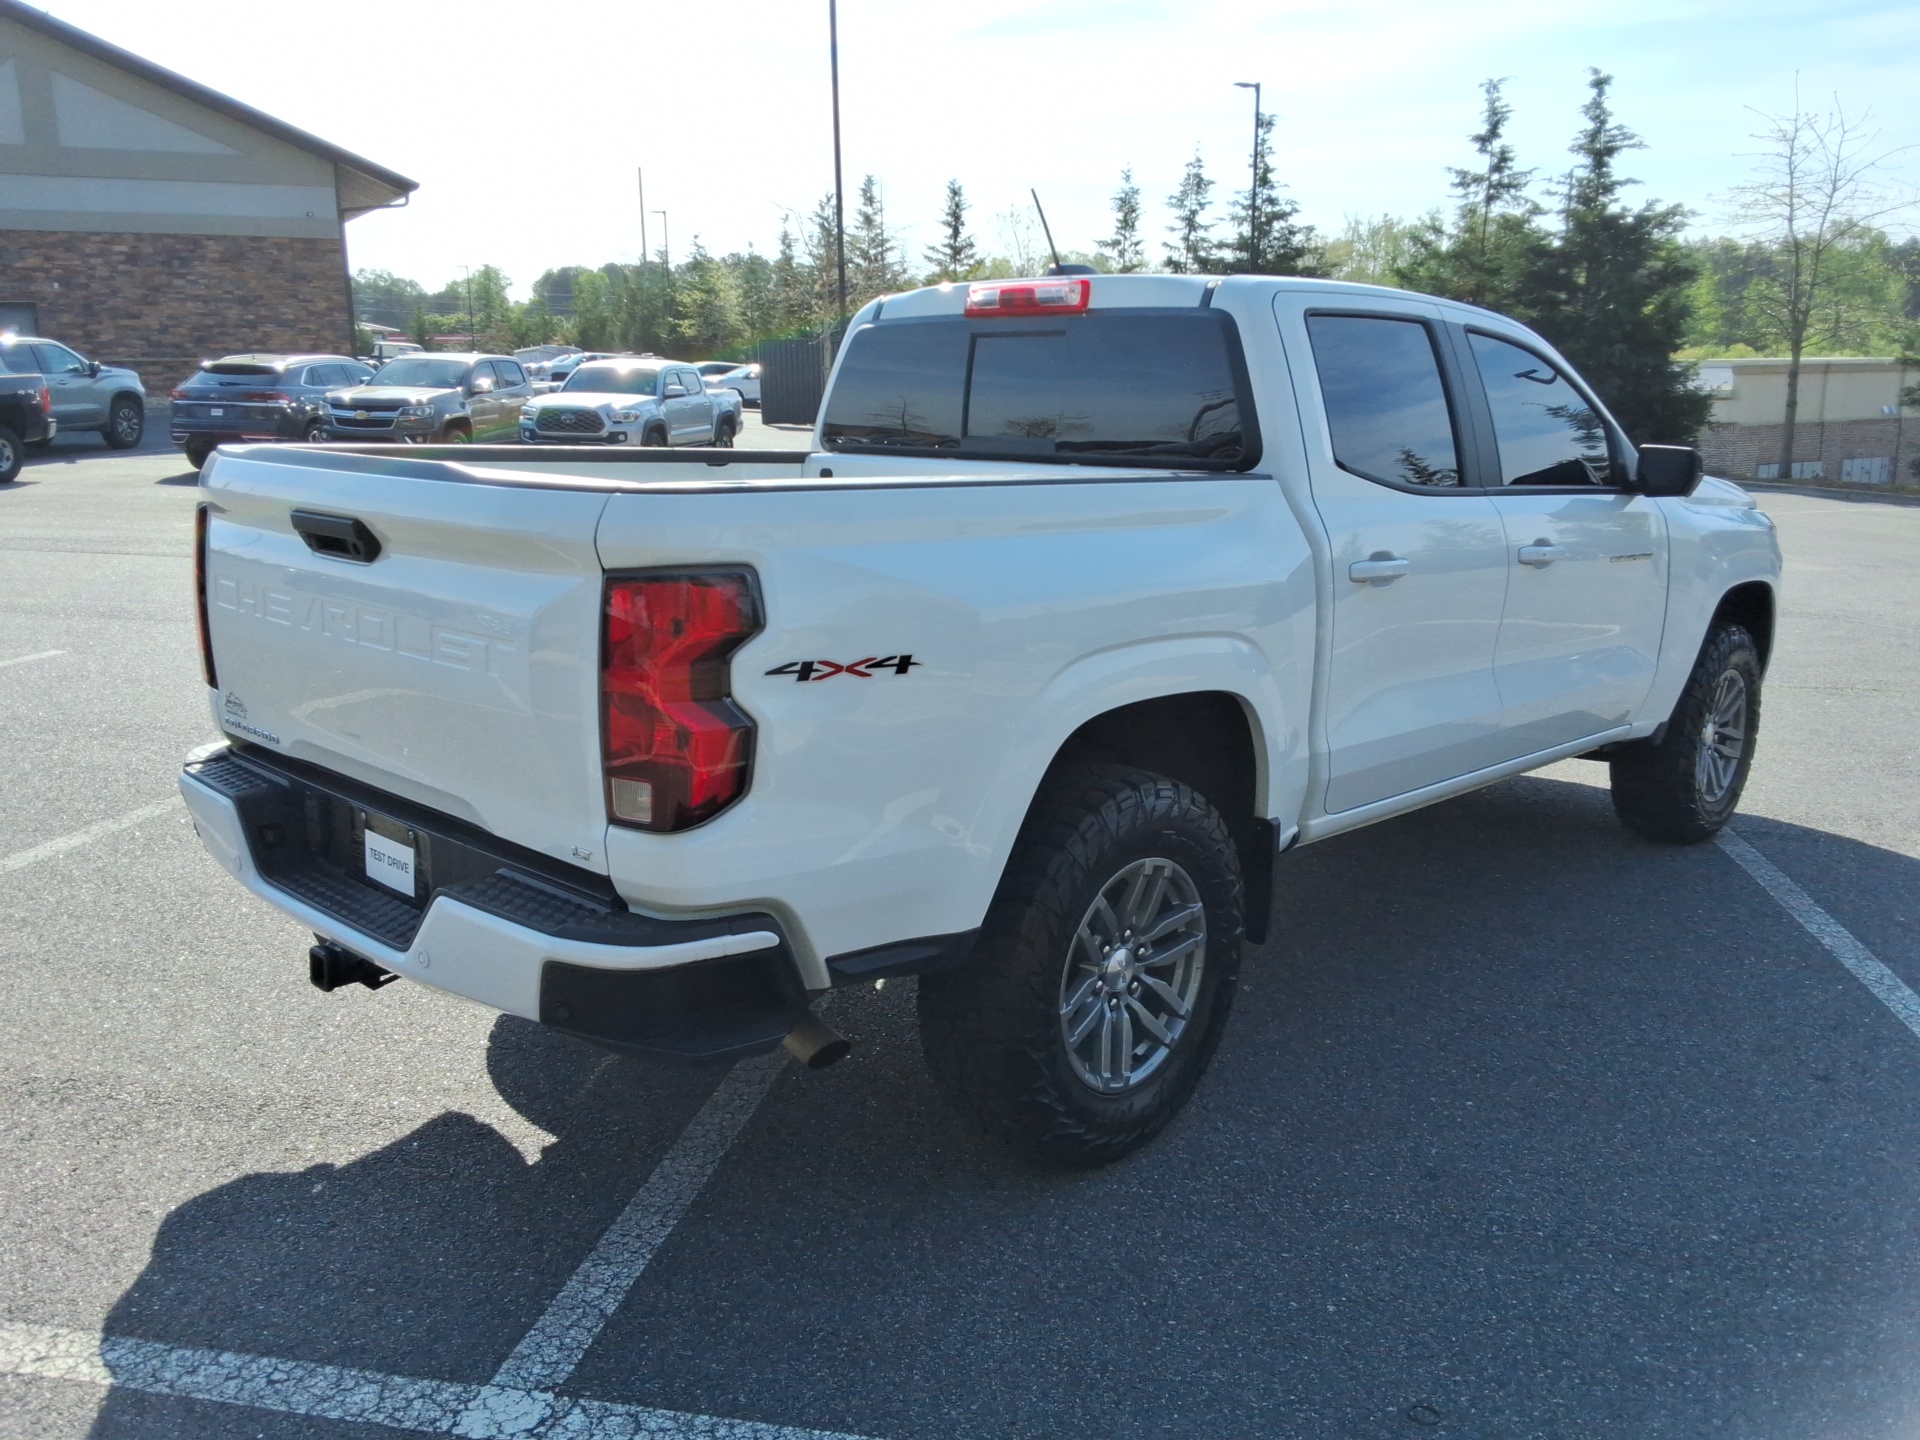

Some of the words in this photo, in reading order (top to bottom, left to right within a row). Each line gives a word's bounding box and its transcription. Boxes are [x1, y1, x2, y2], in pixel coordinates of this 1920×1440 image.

[214, 574, 517, 678] CHEVROLET
[369, 847, 386, 863] TEST
[387, 855, 410, 874] DRIVE
